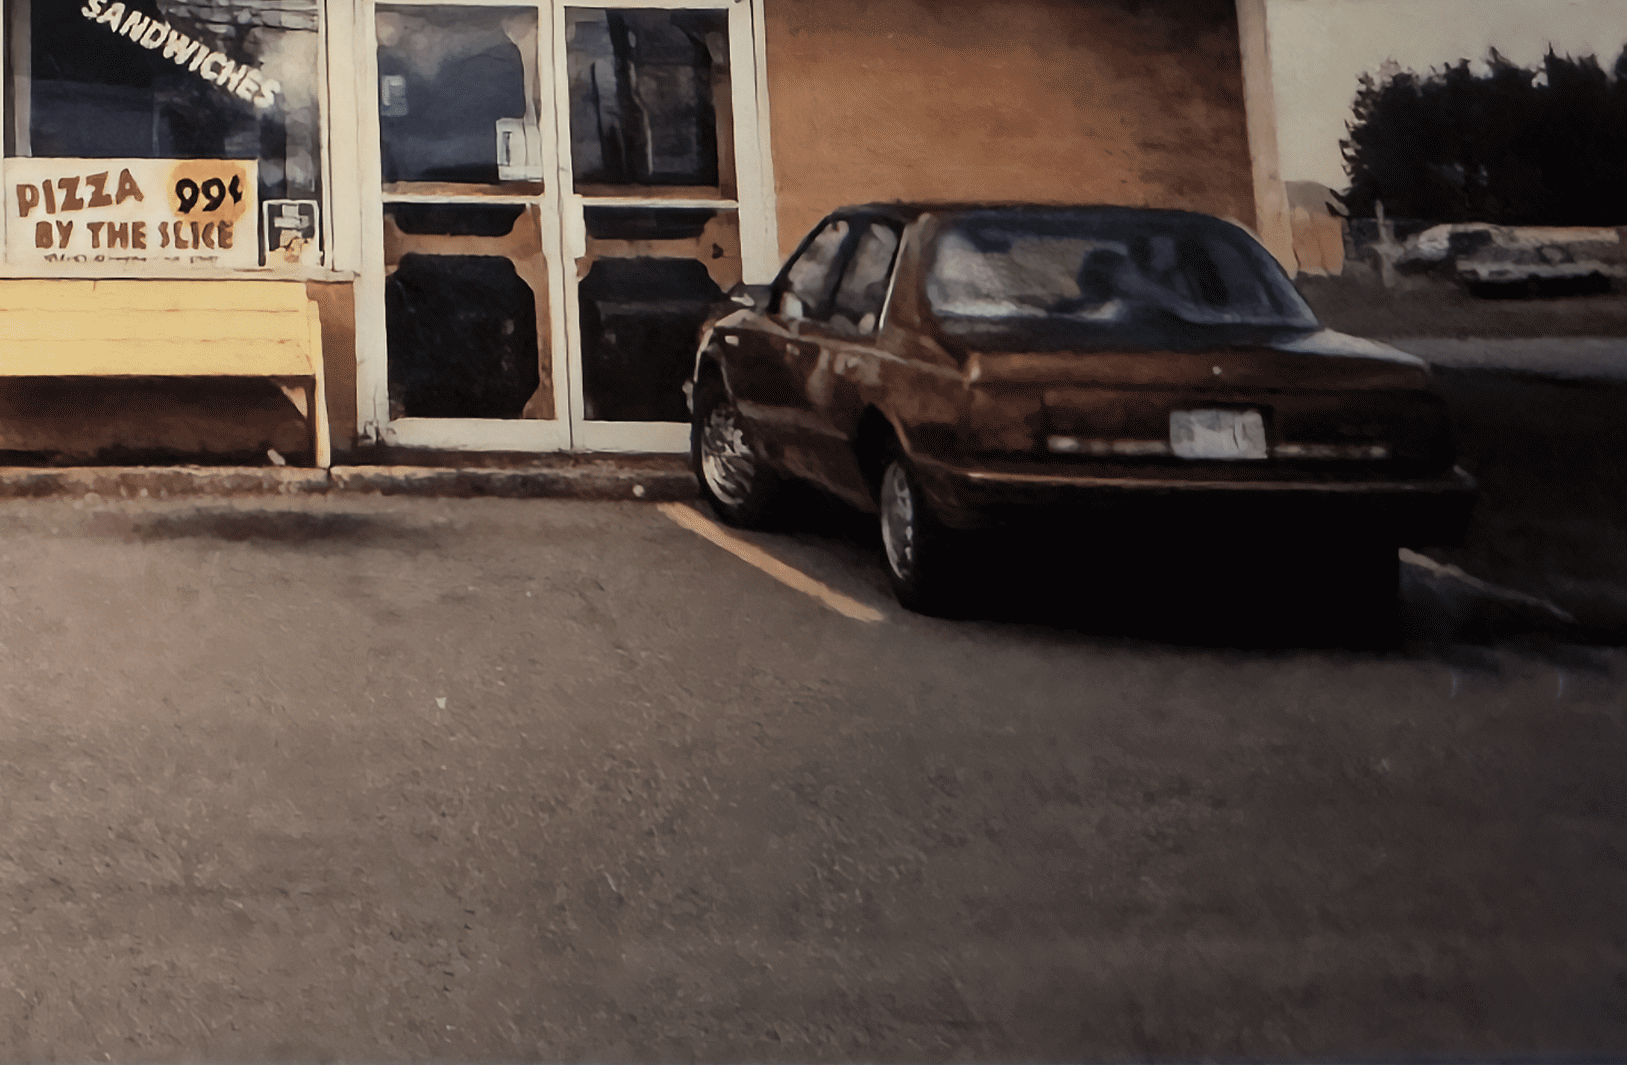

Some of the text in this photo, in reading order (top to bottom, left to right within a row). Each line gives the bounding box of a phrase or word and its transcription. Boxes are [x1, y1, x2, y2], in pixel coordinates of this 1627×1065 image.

[16, 168, 144, 217] PIZZA
[35, 220, 234, 249] BY THE SLICE
